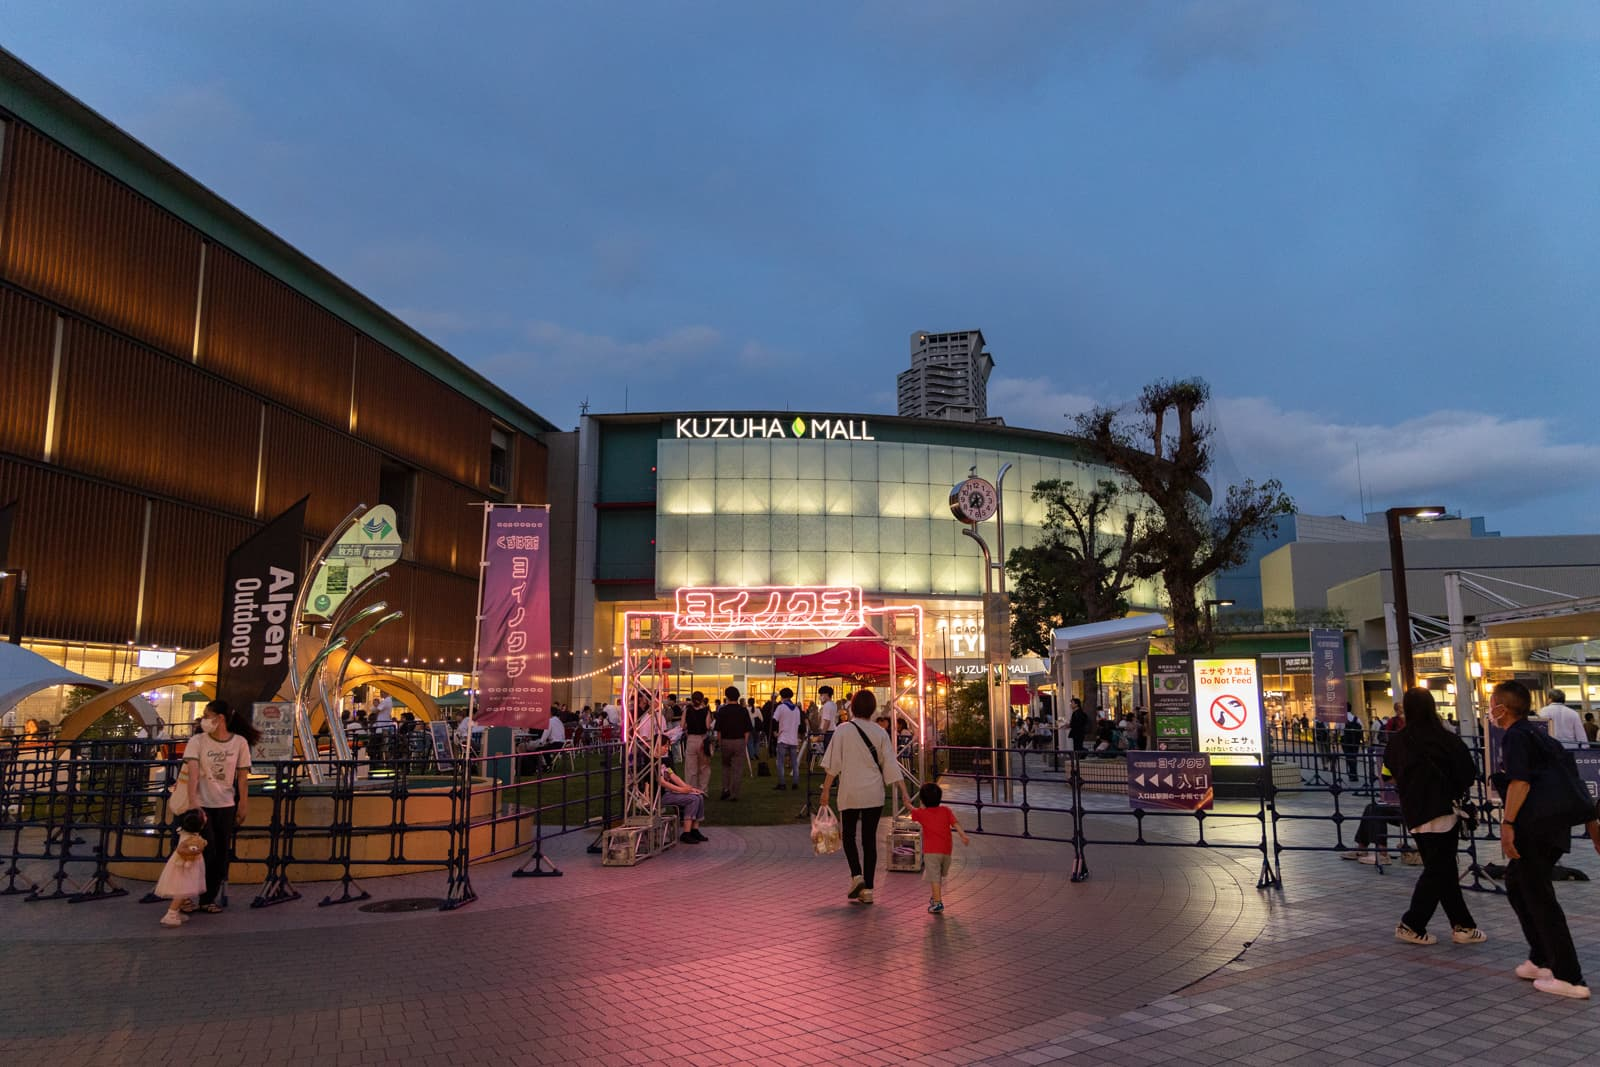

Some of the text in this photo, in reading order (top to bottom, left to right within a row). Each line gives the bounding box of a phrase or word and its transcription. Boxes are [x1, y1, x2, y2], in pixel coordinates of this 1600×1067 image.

[676, 418, 875, 441] KUZUHA MALL
[229, 577, 262, 668] Outdoors
[261, 566, 295, 665] Alpen
[1007, 664, 1031, 673] MALL
[1199, 667, 1252, 676] エサやり禁止
[1214, 676, 1229, 684] Not
[1231, 676, 1252, 684] Feed
[1177, 773, 1209, 790] 入口
